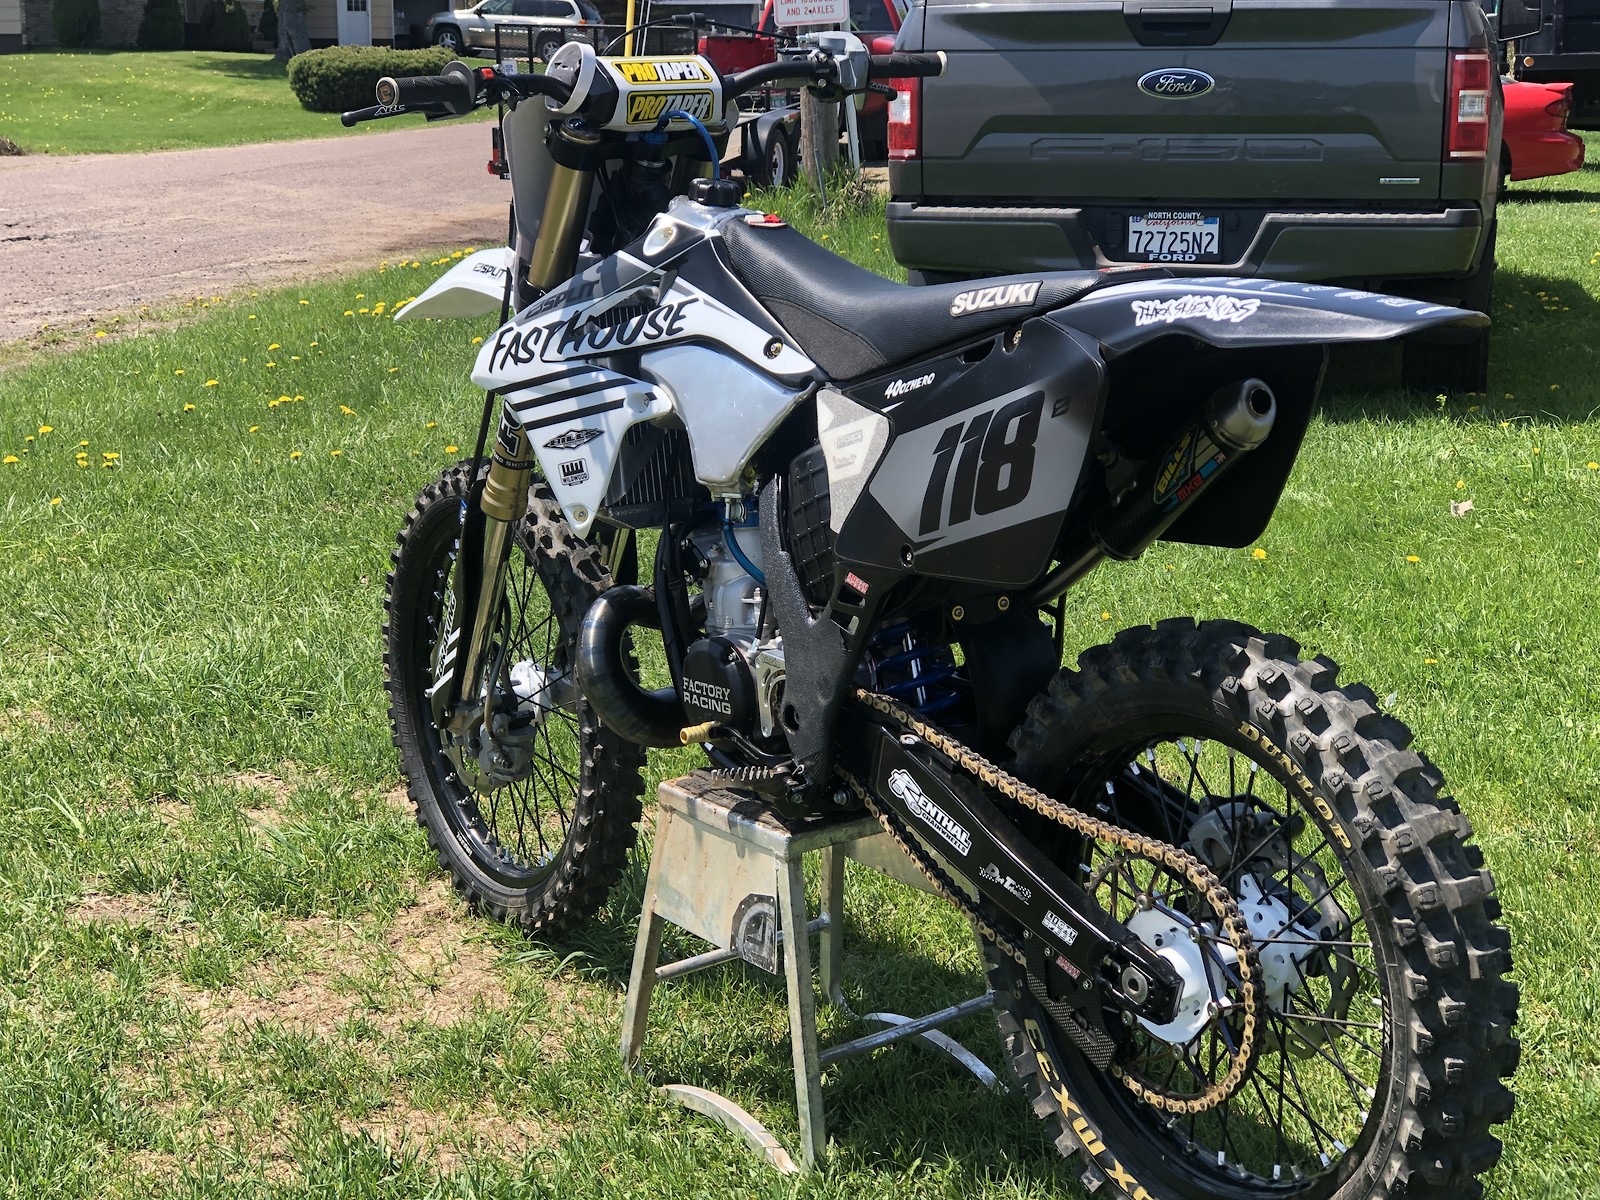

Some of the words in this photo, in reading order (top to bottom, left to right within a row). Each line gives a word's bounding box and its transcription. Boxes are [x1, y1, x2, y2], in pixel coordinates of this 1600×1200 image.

[786, 7, 801, 17] AND
[804, 6, 810, 16] 2
[811, 4, 835, 15] AXLES
[619, 61, 707, 83] PROTAPER
[1155, 73, 1197, 95] Ford
[1029, 136, 1326, 163] F-150
[1148, 211, 1173, 220] NORTH
[1174, 211, 1202, 220] COUNTY
[1132, 230, 1215, 254] 72725N2
[1148, 253, 1197, 262] FORD
[481, 263, 509, 280] SPLIT
[543, 280, 601, 314] SPLIT
[951, 281, 1039, 316] SUZUKI
[918, 389, 1047, 537] 118
[562, 472, 589, 484] WILDWOOD
[682, 676, 731, 701] FACTORY
[683, 691, 732, 715] RACING
[1237, 720, 1352, 849] DUNLOP
[921, 811, 968, 855] CHAINWHEELS
